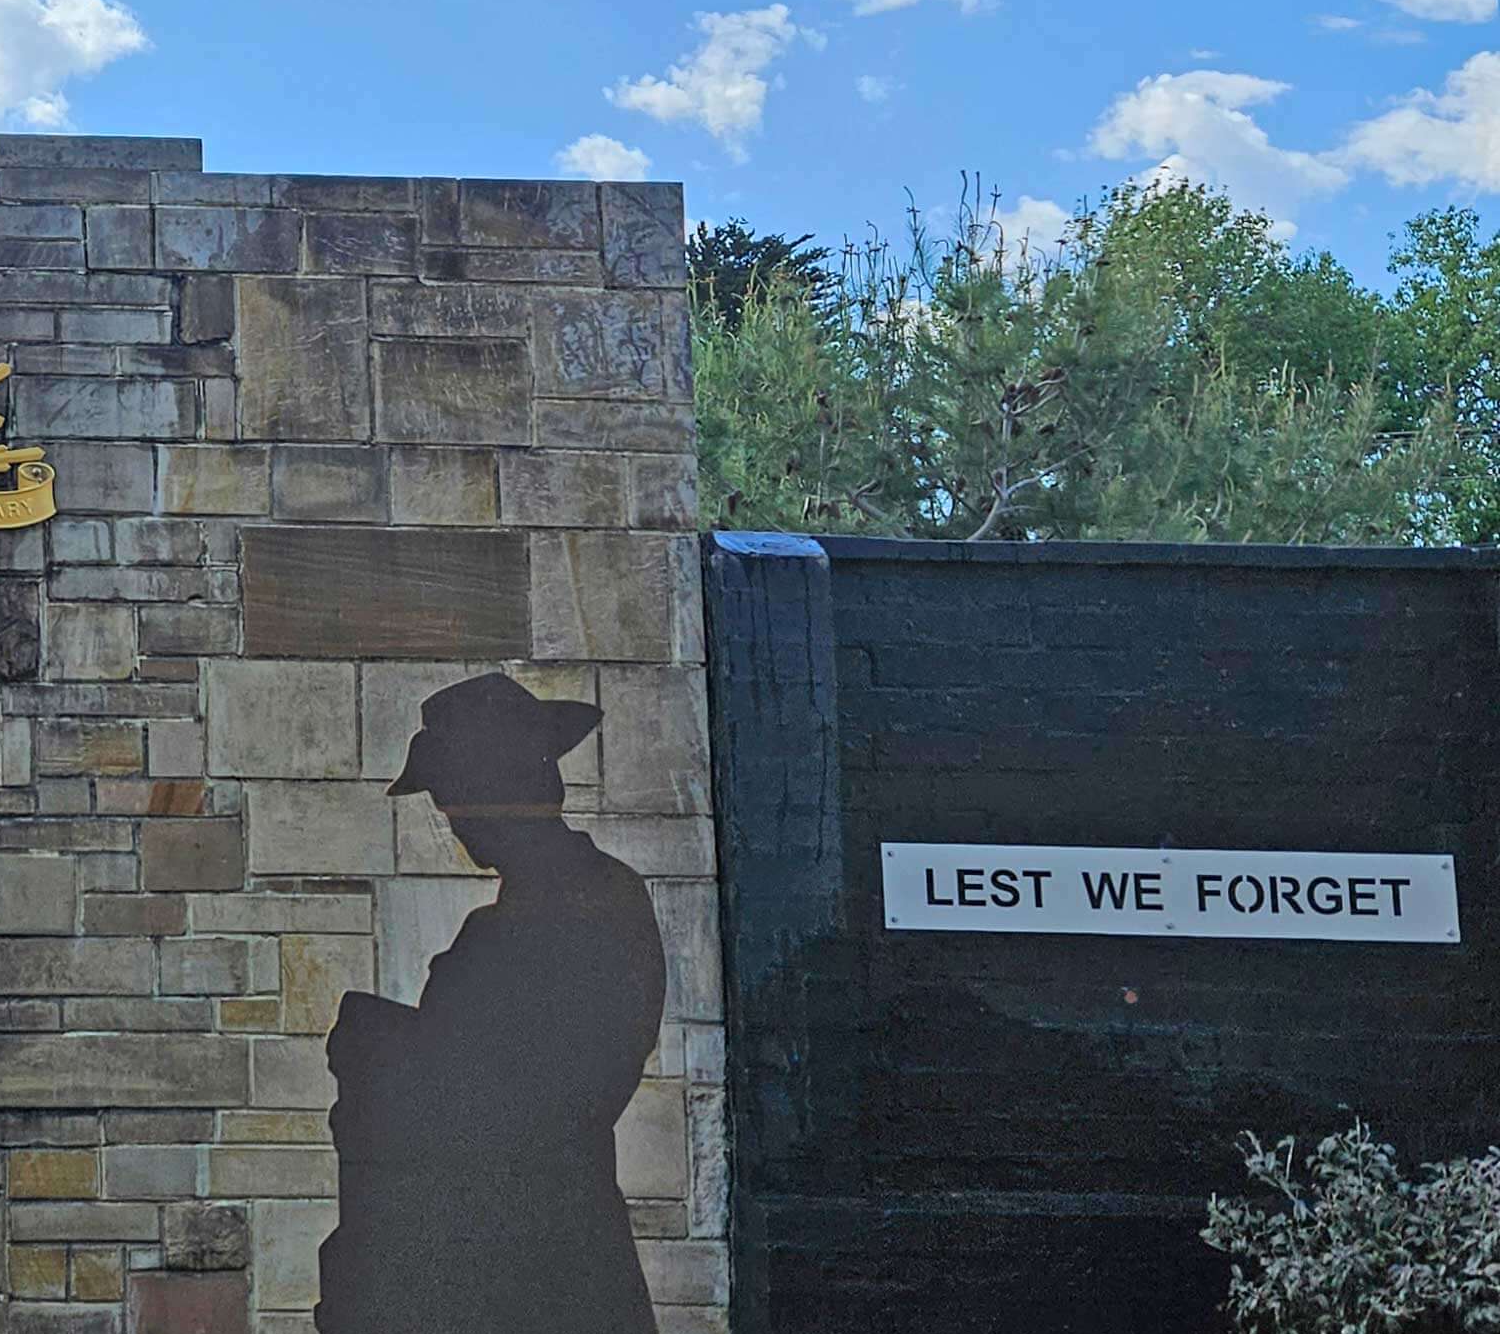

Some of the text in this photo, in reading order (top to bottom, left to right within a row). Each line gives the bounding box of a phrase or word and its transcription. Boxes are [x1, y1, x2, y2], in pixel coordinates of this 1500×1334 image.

[924, 867, 1411, 918] LEST WE FORGET
